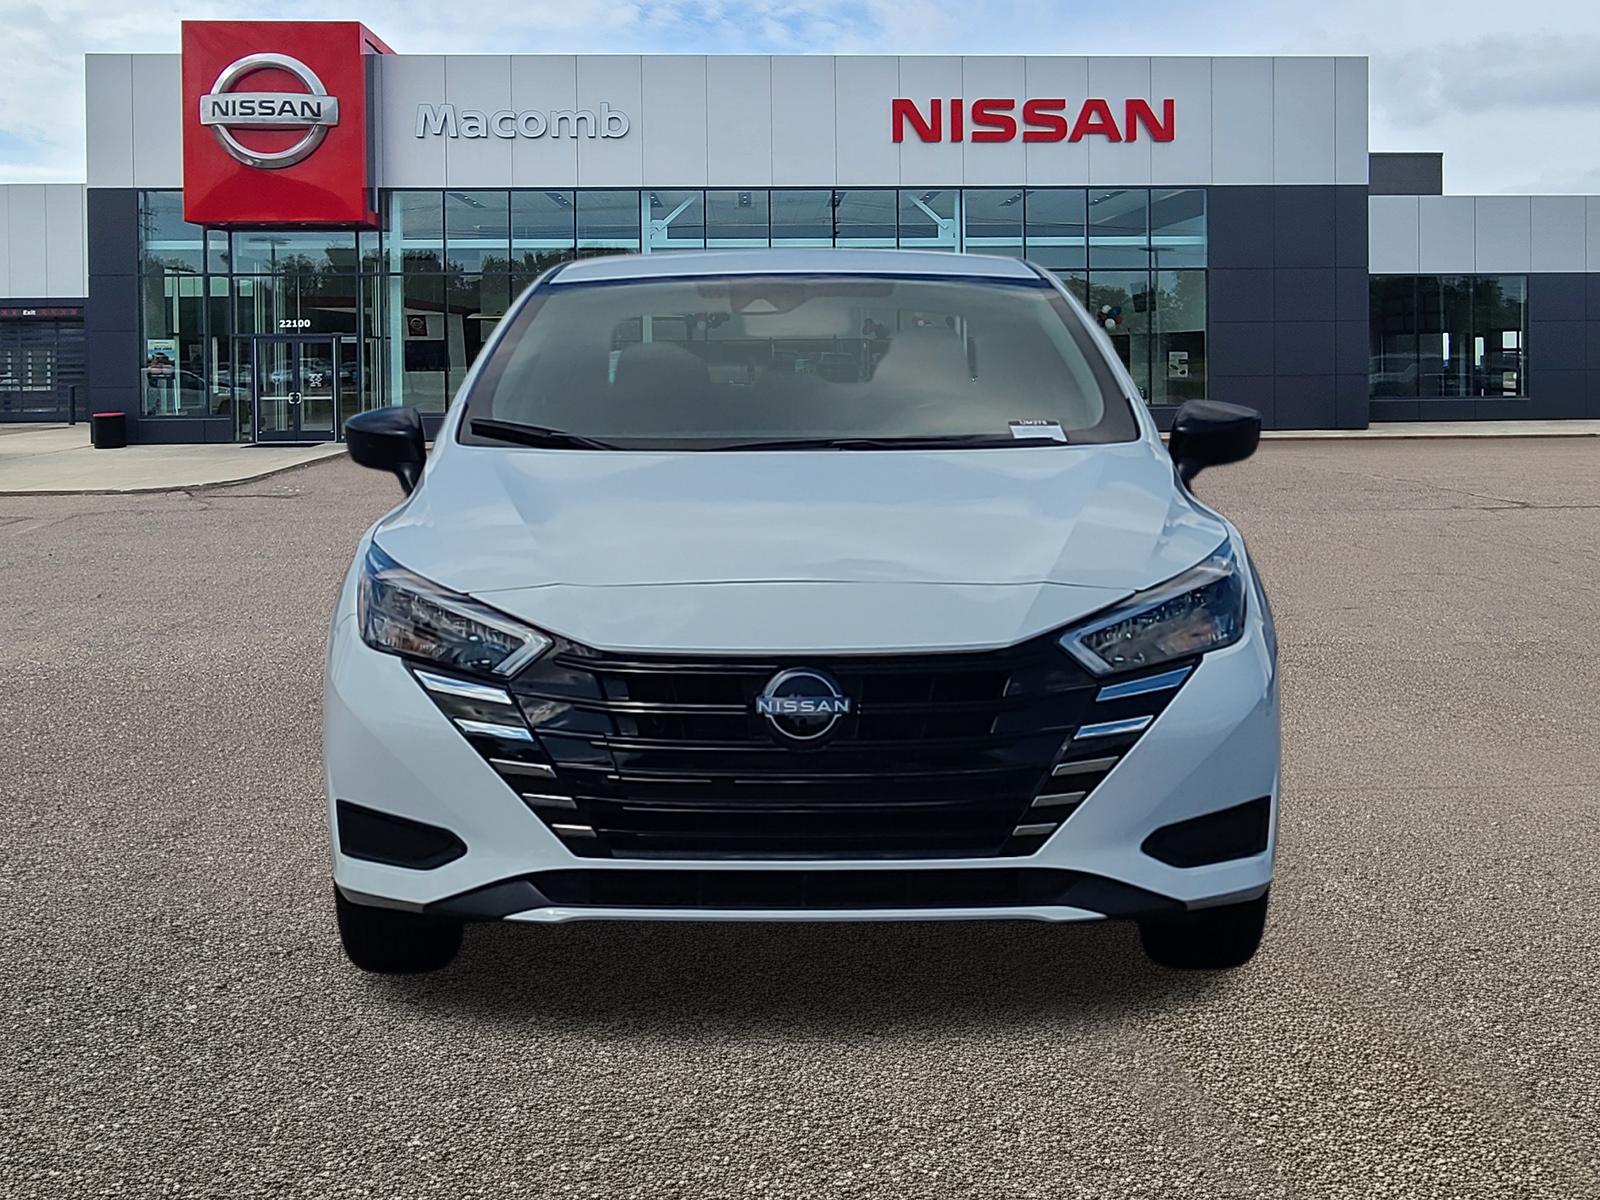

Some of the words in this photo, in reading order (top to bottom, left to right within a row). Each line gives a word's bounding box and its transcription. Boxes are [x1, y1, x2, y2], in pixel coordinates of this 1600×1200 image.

[211, 100, 323, 118] NISSAN
[415, 101, 630, 139] Macomb
[893, 98, 1176, 143] NISSAN
[279, 319, 311, 328] 22100
[758, 699, 849, 713] NISSAN
